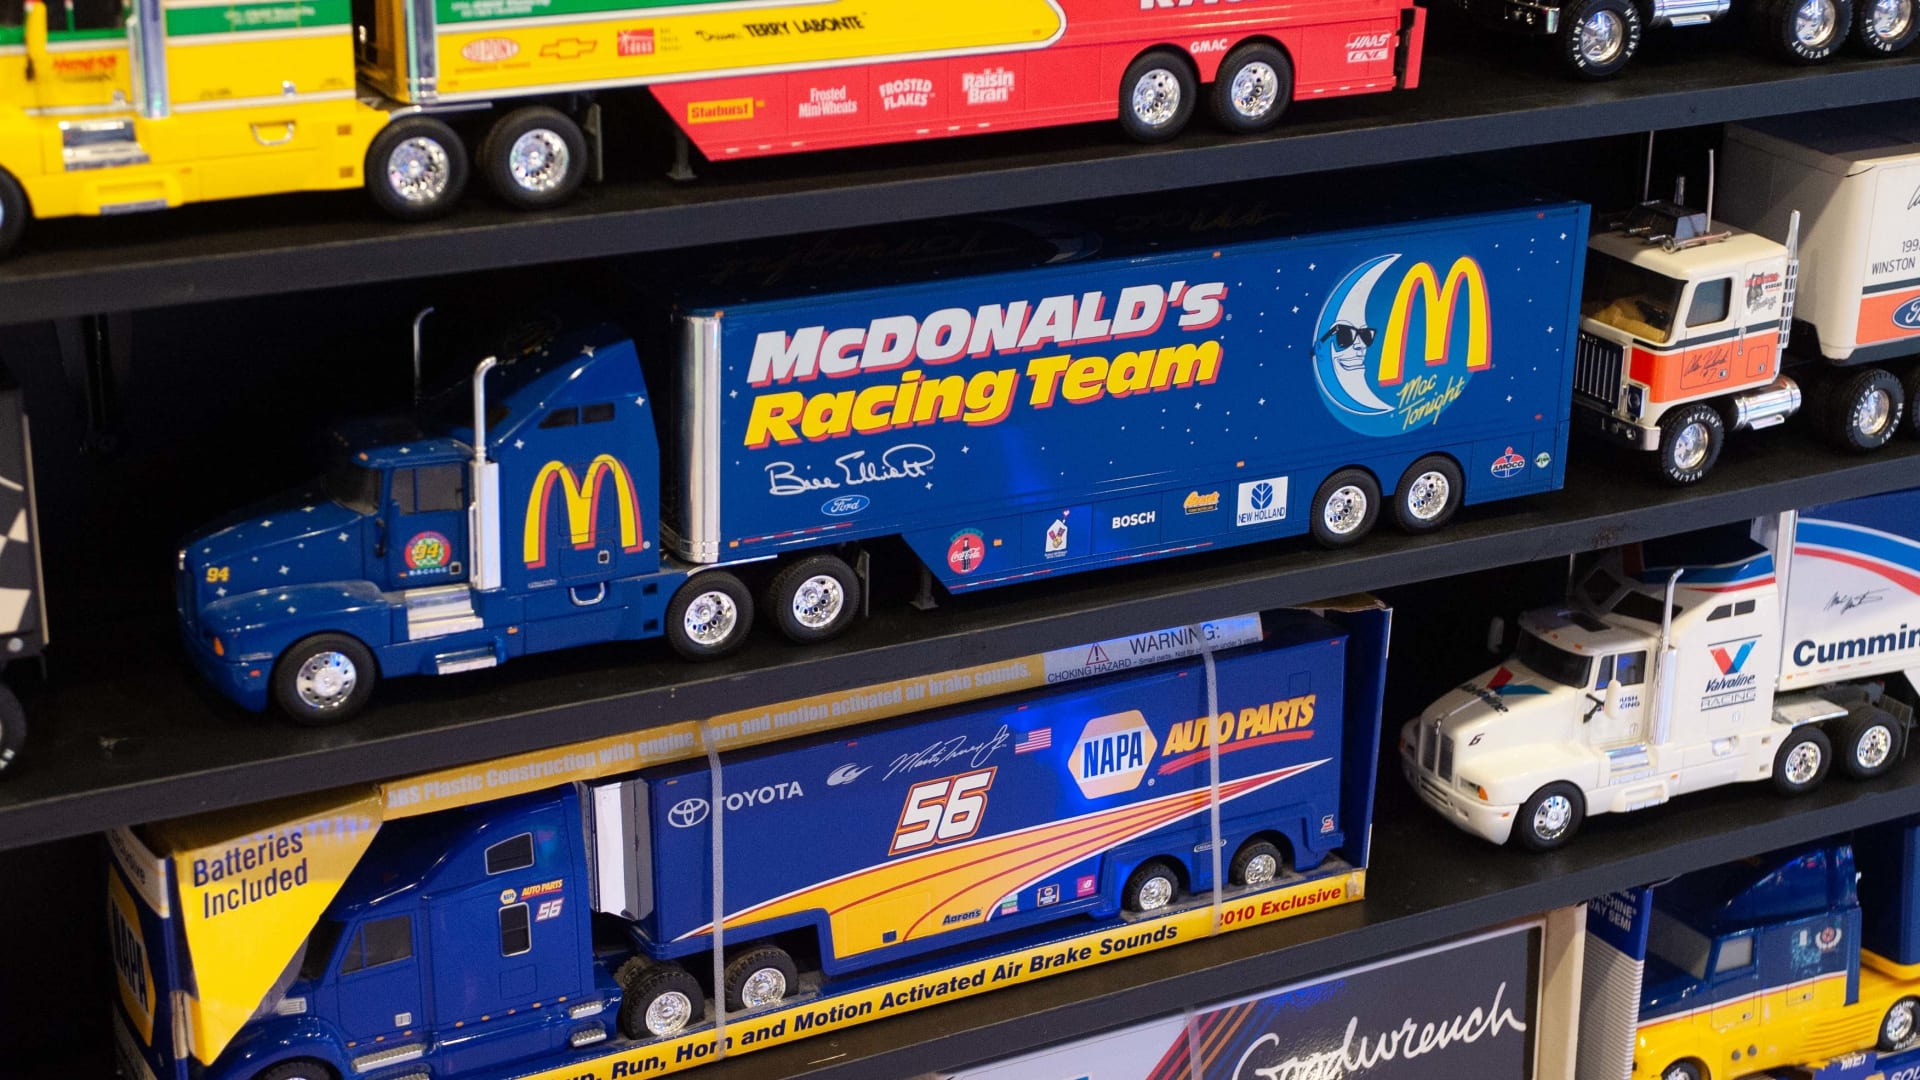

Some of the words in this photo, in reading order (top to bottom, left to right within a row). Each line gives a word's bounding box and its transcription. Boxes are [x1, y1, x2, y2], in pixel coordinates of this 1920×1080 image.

[743, 21, 790, 38] TERRY
[793, 15, 865, 34] LABONTE
[1624, 8, 1638, 58] NYLINT
[1190, 38, 1228, 54] GMAC
[1572, 18, 1586, 68] NYLINT
[1791, 40, 1831, 59] NYLINT
[879, 79, 932, 97] FROSTED
[962, 67, 1015, 91] Raisin
[810, 86, 847, 101] Frosted
[884, 94, 928, 110] FLAKES
[967, 86, 1008, 105] Bran
[691, 104, 749, 119] Starburst
[1902, 238, 1920, 252] 199
[1872, 256, 1915, 275] WINSTON
[744, 368, 1016, 449] Racing
[1026, 340, 1223, 408] Team
[1397, 374, 1437, 406] Mac
[1398, 376, 1465, 431] Tonight
[1852, 384, 1875, 427] NYLINT
[1687, 412, 1720, 429] NYLINT
[1493, 461, 1524, 471] AMOCO
[1670, 468, 1703, 482] NYLINT
[830, 498, 861, 513] Ford
[1239, 512, 1252, 524] NEW
[1254, 507, 1286, 520] HOLLAND
[1112, 511, 1156, 529] BOSCH
[415, 542, 440, 560] 94
[206, 566, 230, 583] 94
[1130, 623, 1221, 655] WARNING:
[1793, 624, 1920, 667] Cummin
[1048, 666, 1093, 683] CHOKING
[1093, 658, 1132, 673] HAZARD
[1705, 674, 1756, 693] Valvoline
[1700, 690, 1757, 707] RACING
[387, 785, 420, 809] ABS
[423, 775, 483, 801] Plastic
[486, 751, 597, 794] Construction
[598, 744, 635, 765] with
[638, 731, 697, 757] engine,
[702, 721, 738, 744] orn
[740, 713, 772, 736] and
[774, 704, 830, 728] motion
[831, 686, 903, 713] activated
[905, 682, 926, 702] air
[928, 673, 973, 697] brake
[974, 662, 1032, 688] sounds.
[1162, 710, 1234, 757] AUTO
[1236, 694, 1316, 741] PARTS
[1468, 733, 1485, 746] 6
[1083, 730, 1143, 780] NAPA
[721, 781, 804, 811] TOYOTA
[889, 766, 998, 856] 56
[193, 832, 304, 887] Batteries
[204, 858, 309, 919] Included
[521, 885, 541, 897] AUTO
[541, 879, 564, 892] PARTS
[534, 897, 565, 922] 56
[942, 908, 982, 925] Aaron's
[1218, 905, 1255, 927] 2010
[1260, 887, 1341, 917] Exclusive
[1608, 909, 1632, 932] SEMI
[112, 897, 150, 1013] NAPA
[612, 1056, 666, 1079] Run,
[675, 1034, 732, 1063] Horn
[740, 1018, 786, 1044] and
[793, 999, 872, 1031] Motion
[879, 969, 985, 1011] Activated
[991, 961, 1023, 983] Air
[1029, 944, 1091, 973] Brake
[1099, 924, 1178, 955] Sounds
